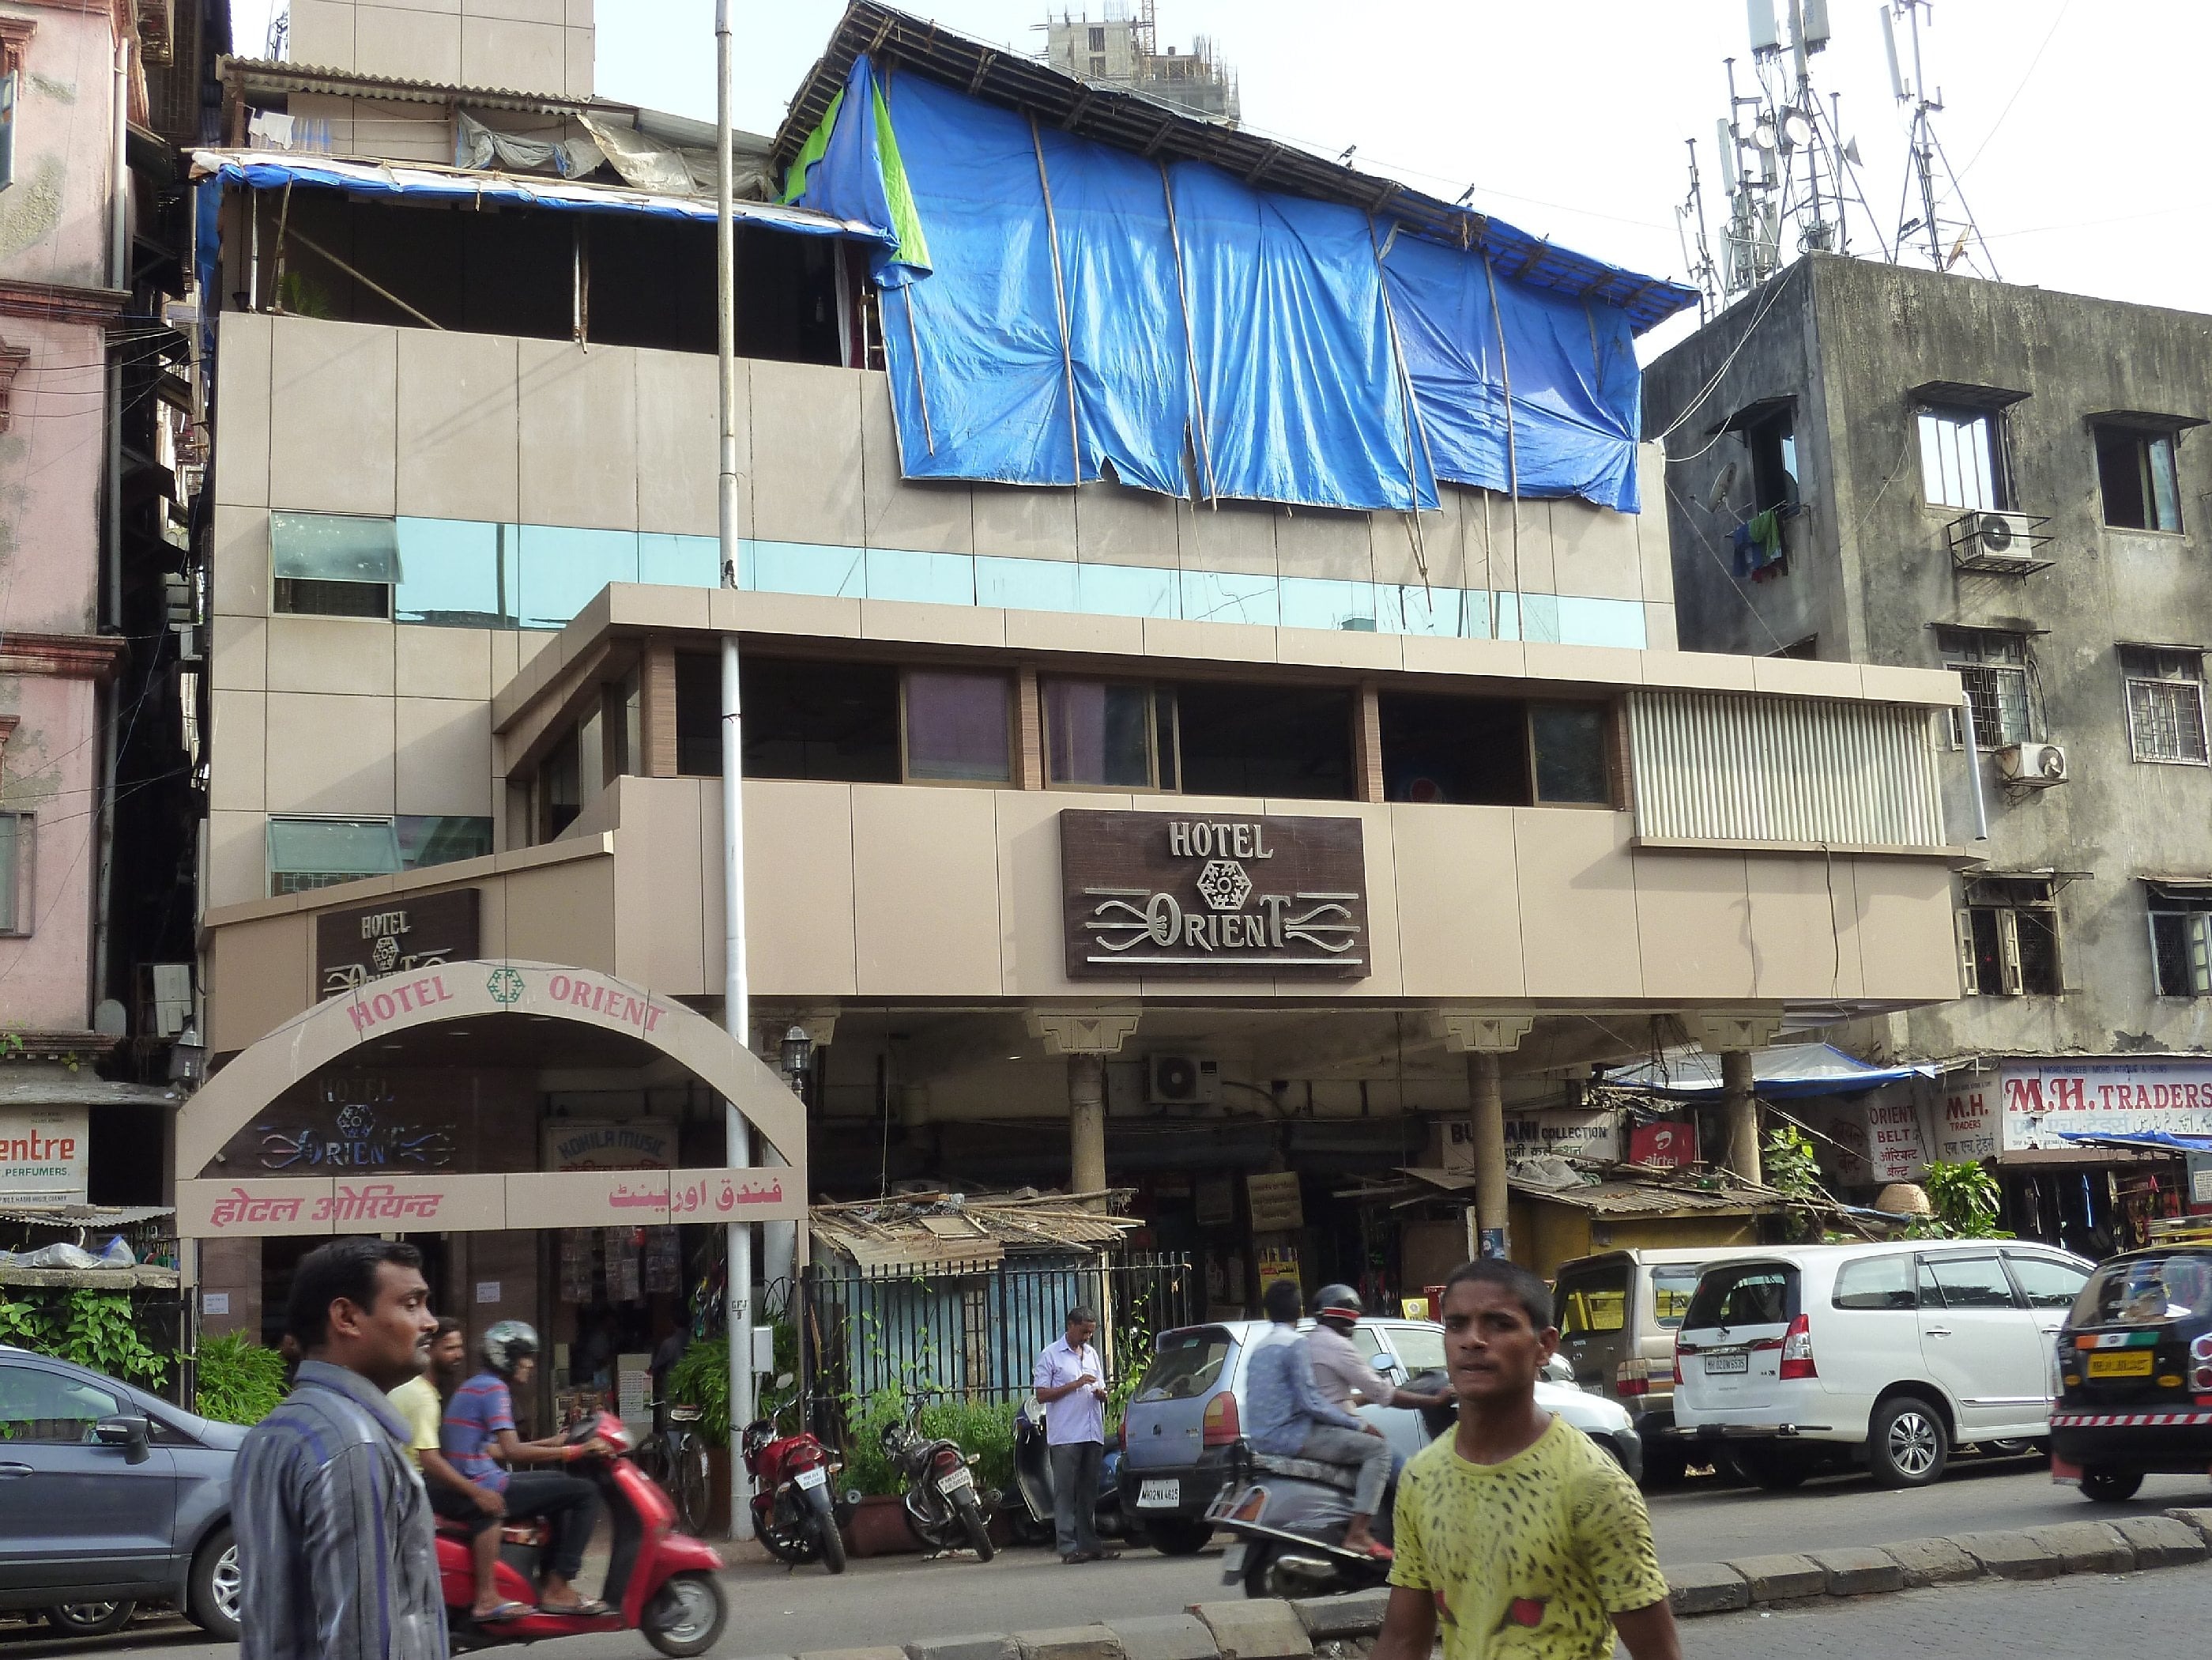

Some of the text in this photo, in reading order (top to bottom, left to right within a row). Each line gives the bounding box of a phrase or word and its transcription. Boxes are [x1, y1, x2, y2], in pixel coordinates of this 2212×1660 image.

[1169, 821, 1274, 858] HOTEL
[360, 911, 411, 939] HOTEL
[1147, 892, 1291, 952] ORIENT
[346, 974, 666, 1032] HOTEL ORIENT
[1946, 1093, 1988, 1121] M.H.
[2005, 1077, 2095, 1111] M.H.
[2097, 1083, 2212, 1110] TRADERS
[1870, 1105, 1916, 1125] ORIENT
[1949, 1119, 1981, 1132] TRADERS
[1541, 1126, 1607, 1139] COLLECTION
[1877, 1129, 1910, 1143] BELT
[1645, 1153, 1679, 1167] airtel
[209, 1184, 444, 1228] होटल ओरियन्ट
[714, 1176, 782, 1212] فندق
